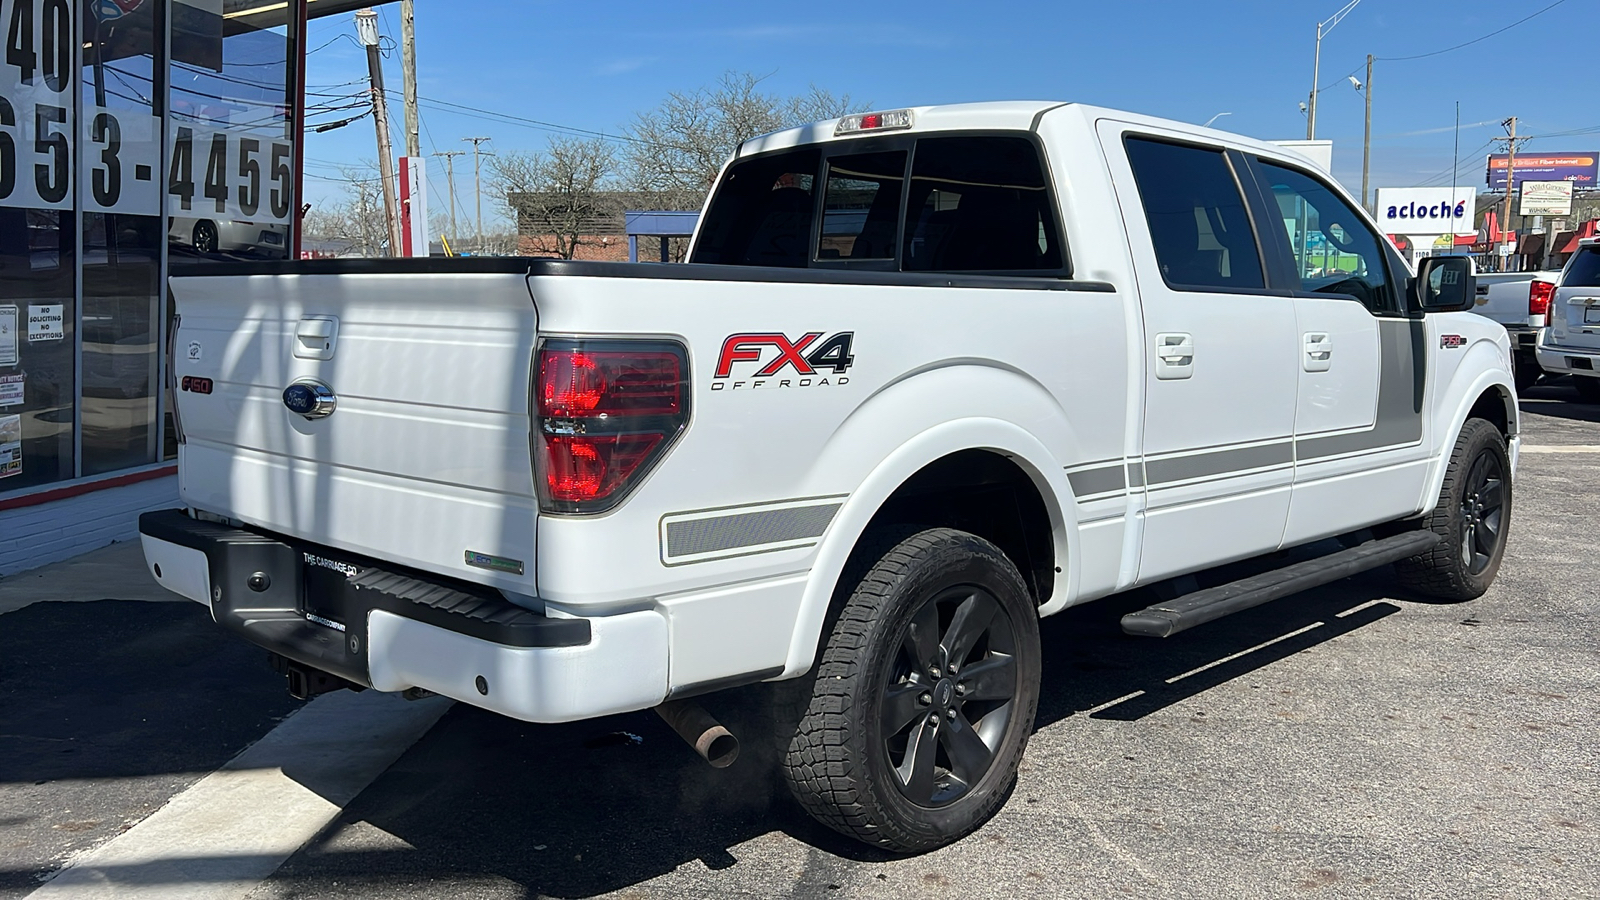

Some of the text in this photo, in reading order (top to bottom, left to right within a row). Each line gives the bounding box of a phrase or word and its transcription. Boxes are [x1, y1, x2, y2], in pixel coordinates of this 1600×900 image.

[1387, 200, 1466, 219] acloché
[30, 315, 61, 323] SOLICITING
[29, 332, 63, 340] EXCEPTIONS
[713, 331, 855, 379] FX4
[711, 377, 850, 391] OFF ROAD
[287, 389, 308, 408] Ford
[303, 552, 316, 563] THE
[316, 556, 347, 573] CARRIAGE
